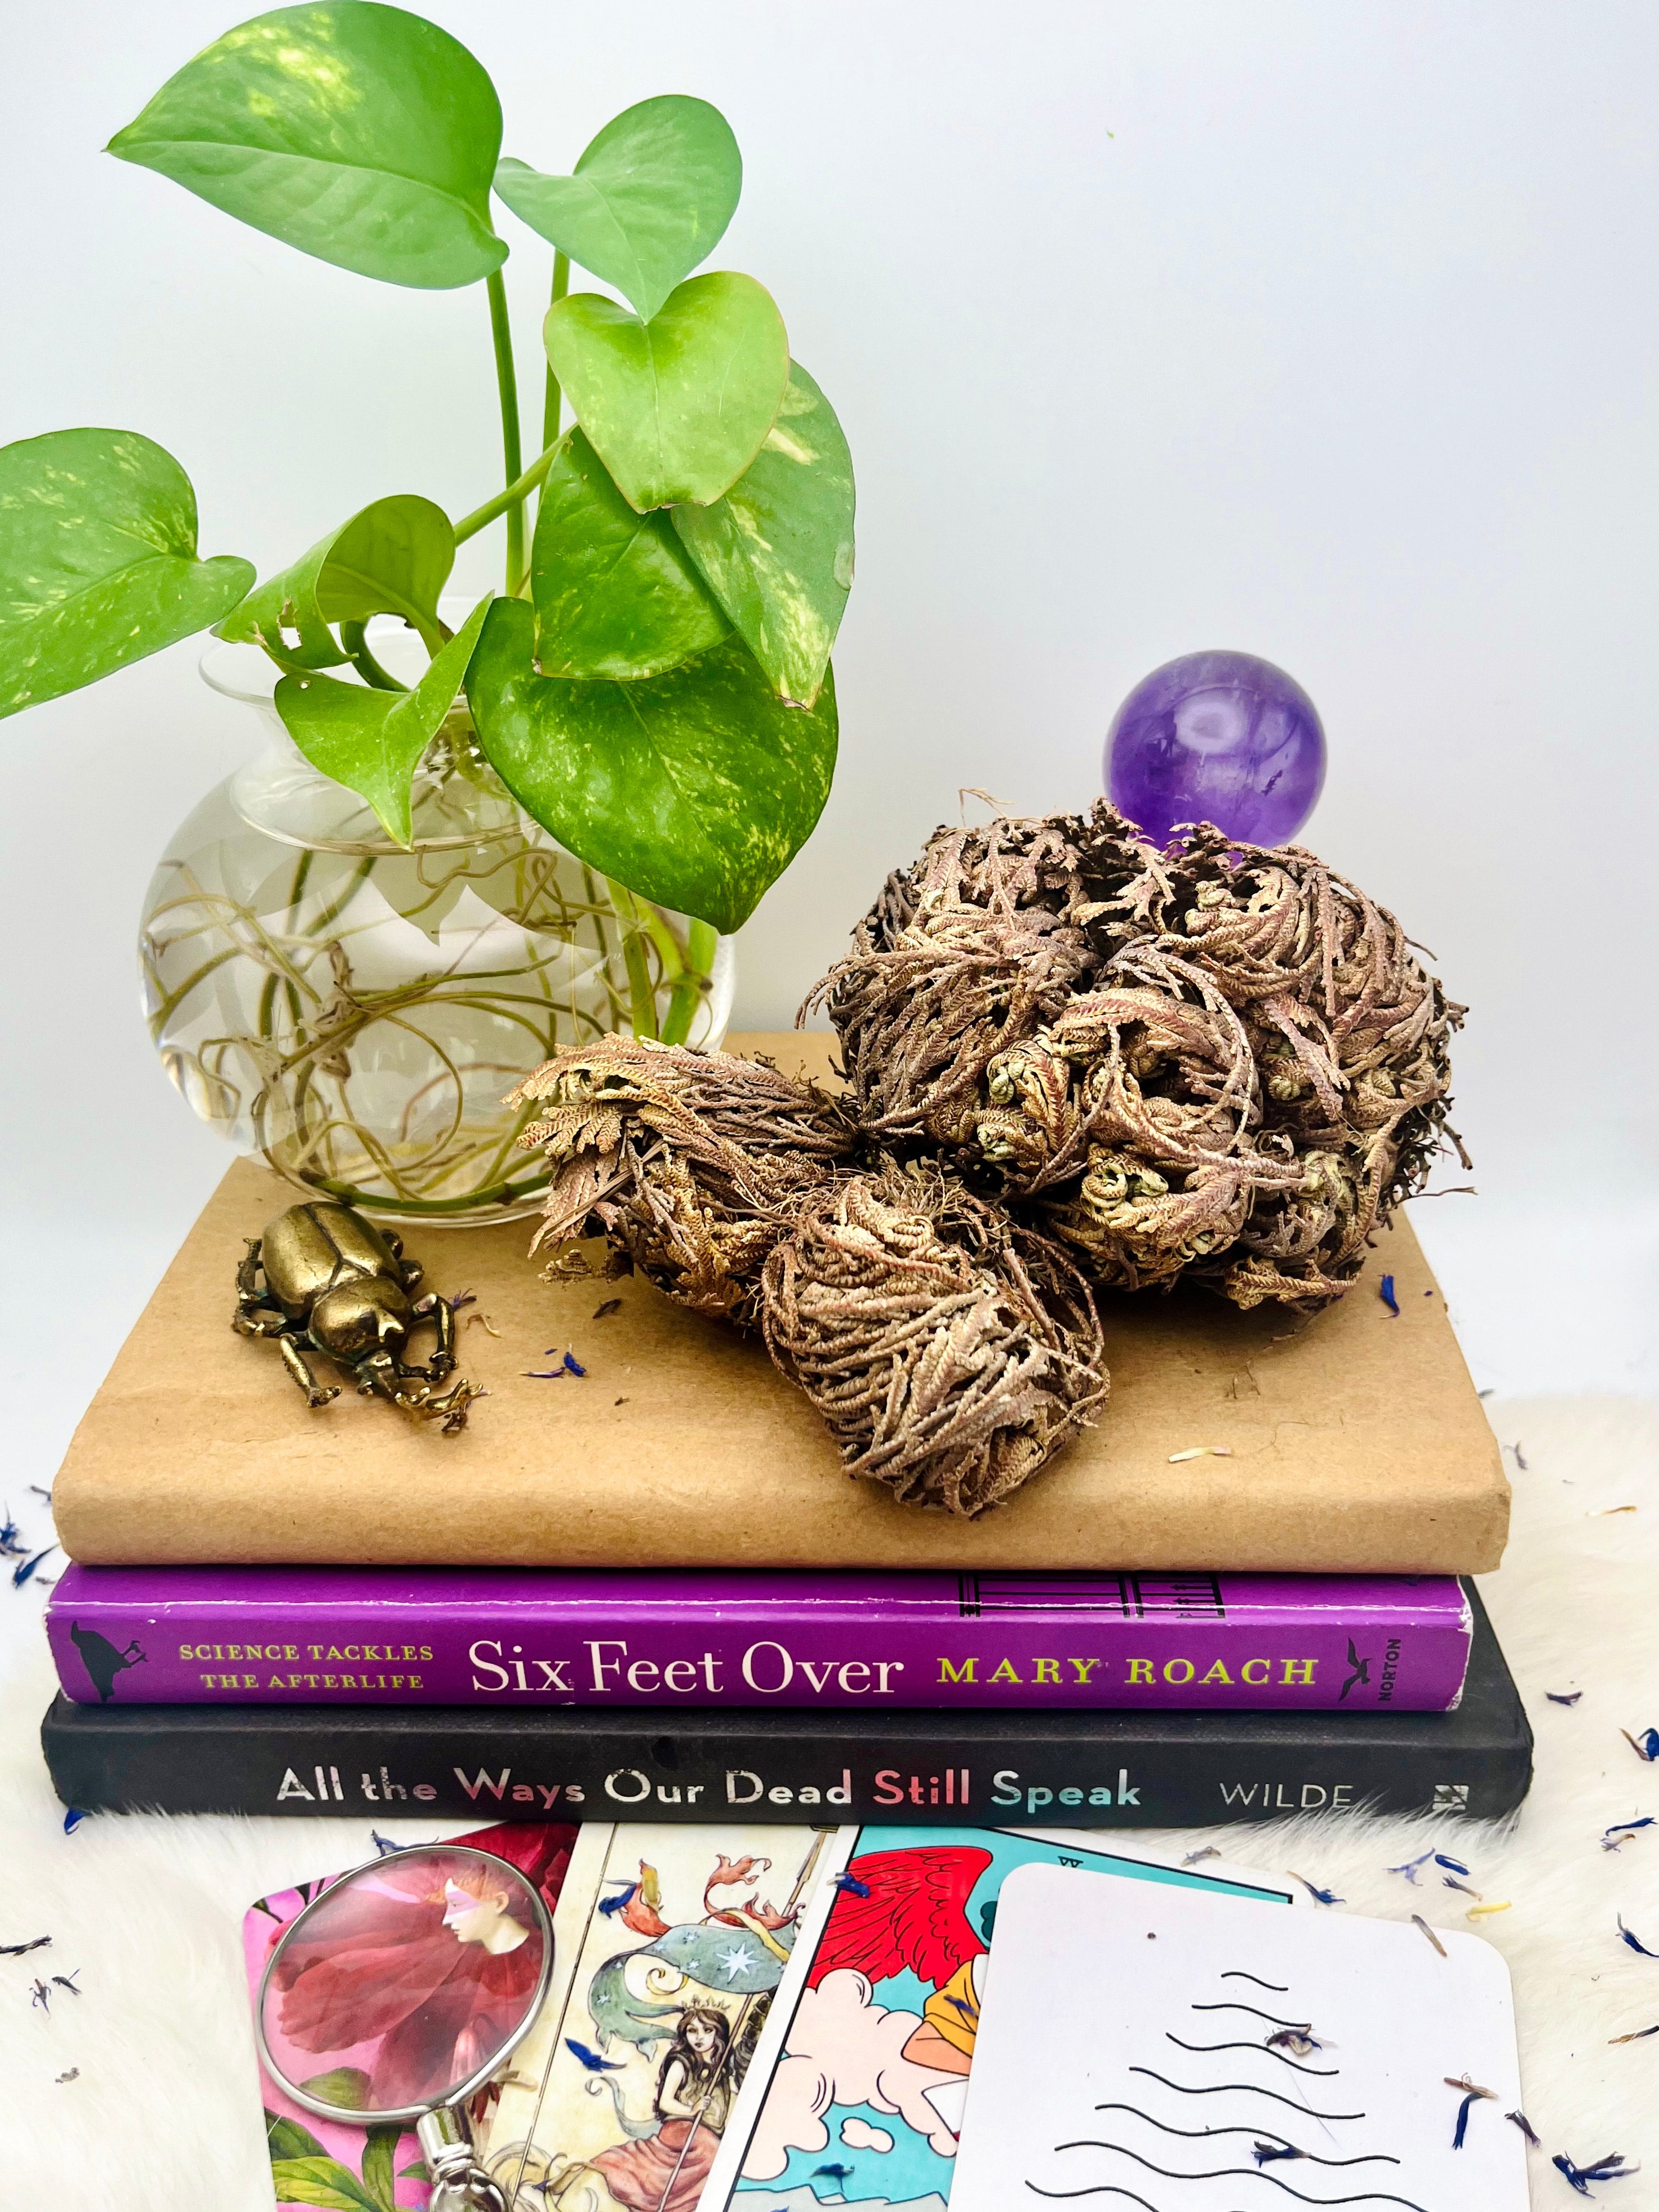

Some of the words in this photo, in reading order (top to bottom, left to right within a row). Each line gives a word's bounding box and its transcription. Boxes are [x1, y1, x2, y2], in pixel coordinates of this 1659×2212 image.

[179, 1645, 300, 1660] SCIENCE
[308, 1646, 432, 1659] TACKLES
[469, 1641, 574, 1690] Six
[584, 1641, 723, 1691] Feet
[742, 1641, 904, 1693] Over
[937, 1658, 1099, 1683] MARY
[1125, 1659, 1319, 1684] ROACH
[1377, 1639, 1401, 1701] NORTON
[200, 1674, 259, 1688] THE
[268, 1674, 424, 1689] AFTERLIFE
[277, 1766, 344, 1800] All
[361, 1767, 436, 1800] the
[454, 1768, 584, 1809] Ways
[605, 1769, 704, 1802] Our
[726, 1769, 851, 1804] Dead
[873, 1769, 969, 1804] Still
[991, 1769, 1140, 1813] Speak
[1220, 1783, 1355, 1809] WILDE
